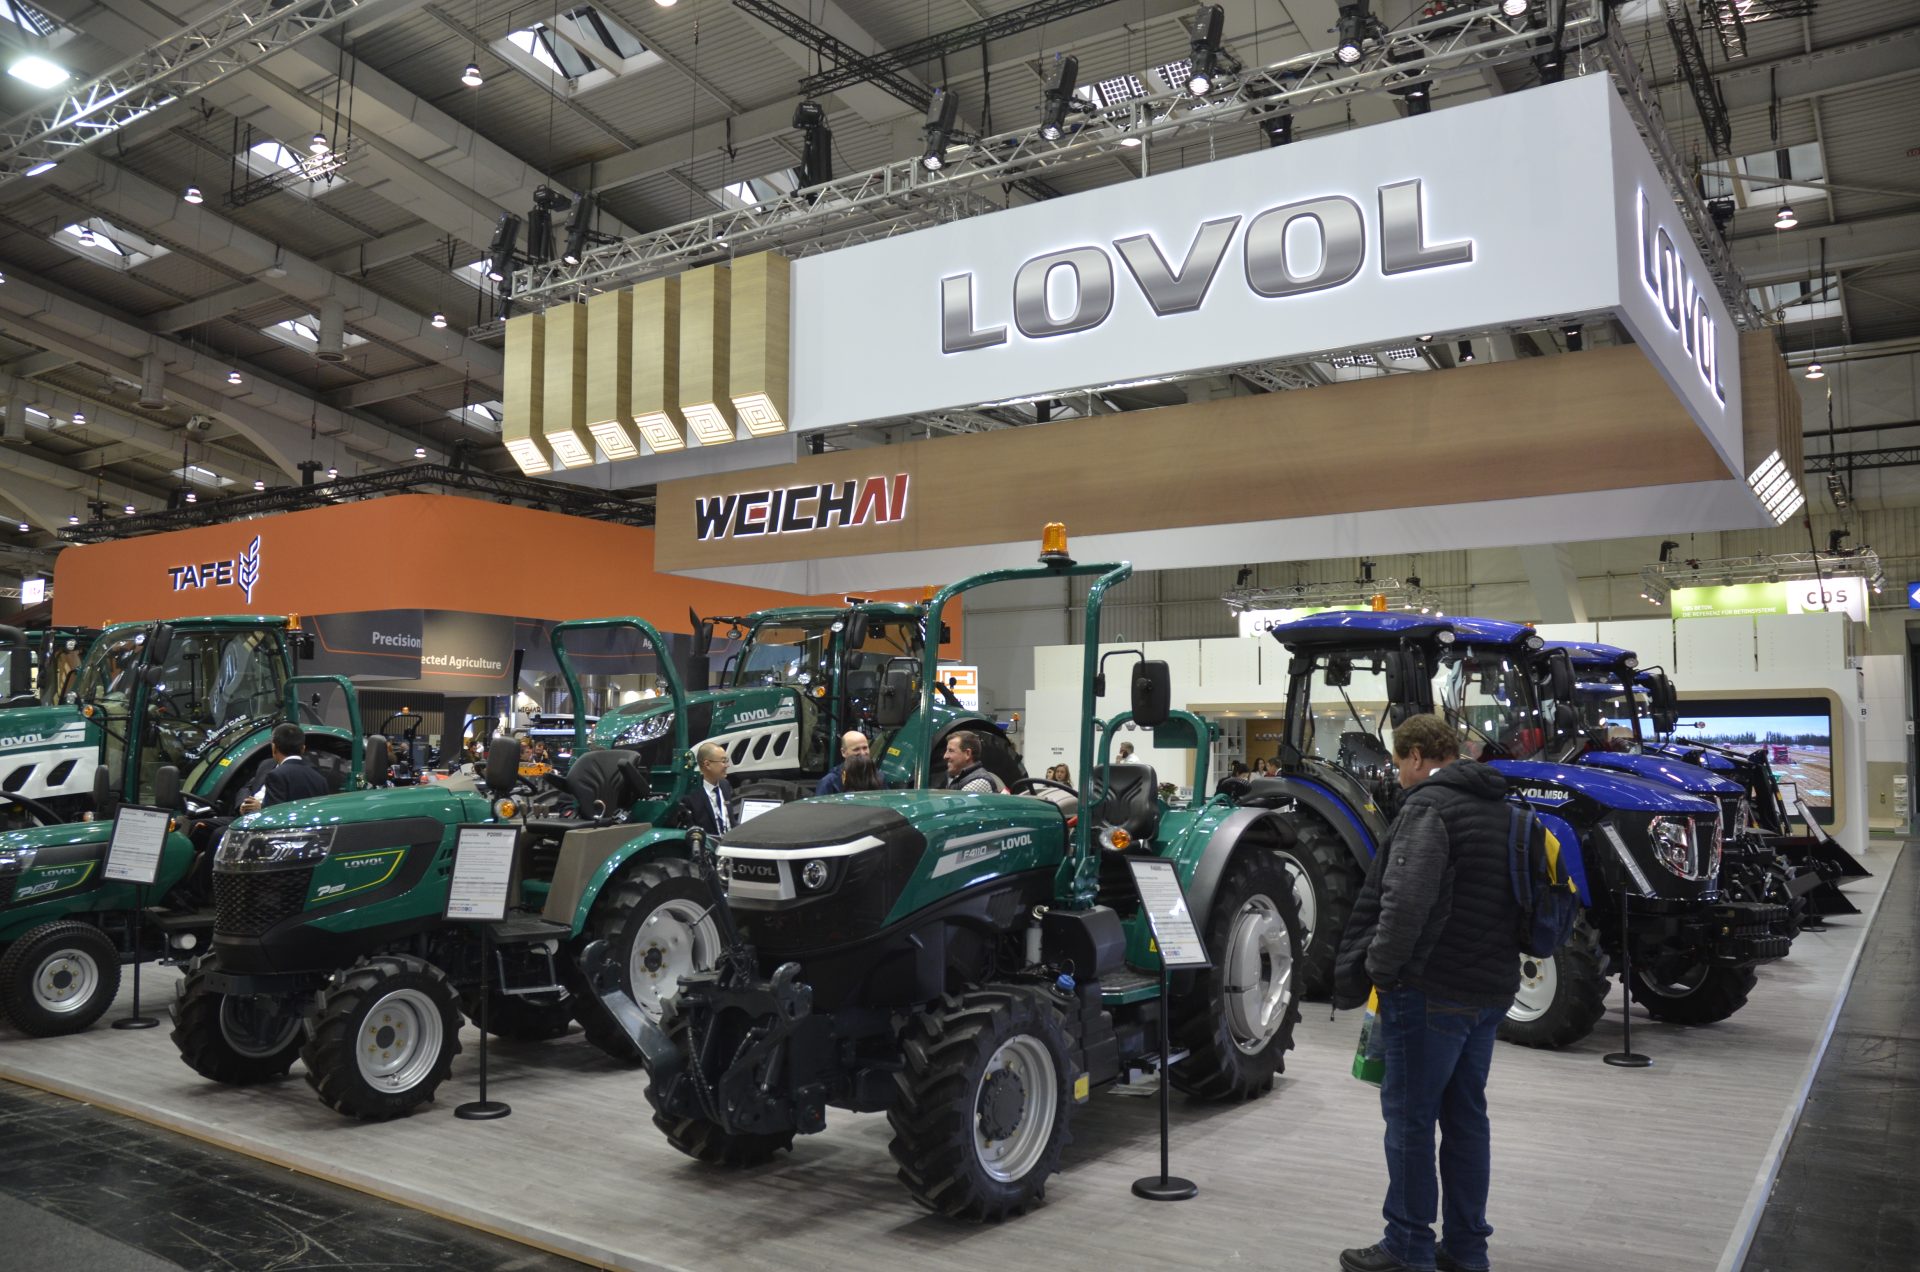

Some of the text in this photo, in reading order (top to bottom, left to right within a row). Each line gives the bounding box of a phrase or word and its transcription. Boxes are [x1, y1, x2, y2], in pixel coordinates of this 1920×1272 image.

[941, 178, 1473, 354] LOVOL
[1637, 187, 1725, 408] LOVOL
[695, 474, 909, 540] WEICHAI
[168, 560, 234, 591] TAFE
[372, 631, 421, 648] Precision
[420, 654, 501, 670] ected Agriculture
[733, 708, 770, 723] LOVOL
[0, 733, 46, 747] OVOL
[963, 834, 1032, 859] F4110 LOVOL
[344, 858, 384, 869] LOVOL
[41, 868, 77, 877] LOVOL
